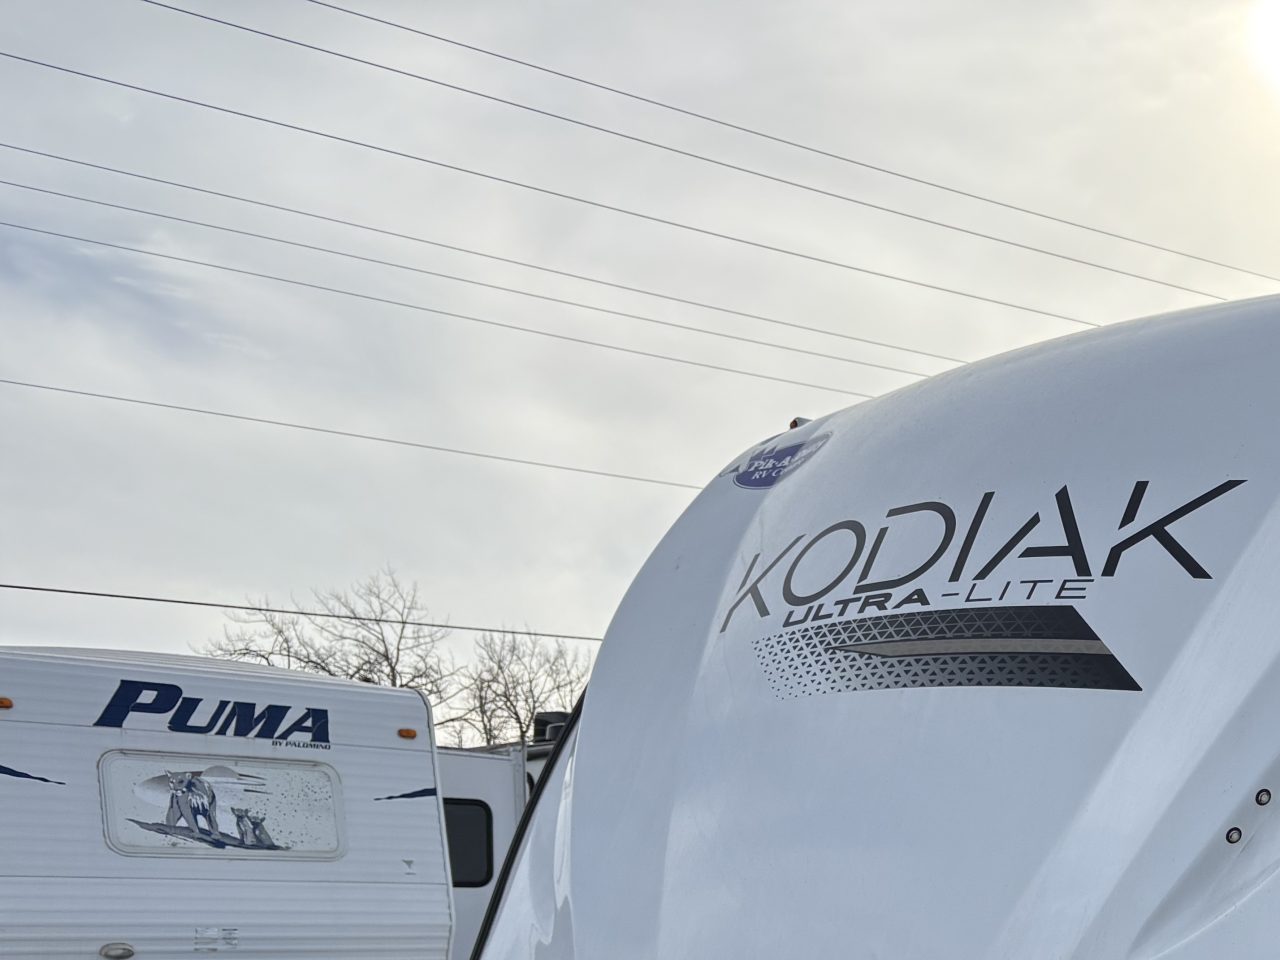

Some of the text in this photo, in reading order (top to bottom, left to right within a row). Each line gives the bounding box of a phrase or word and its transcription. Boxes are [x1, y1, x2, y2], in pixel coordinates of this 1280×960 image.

[720, 479, 1248, 633] KODIAK
[782, 578, 1095, 628] ULTRA-LITE
[92, 679, 330, 743] PUMA
[285, 740, 331, 750] PALOMINO
